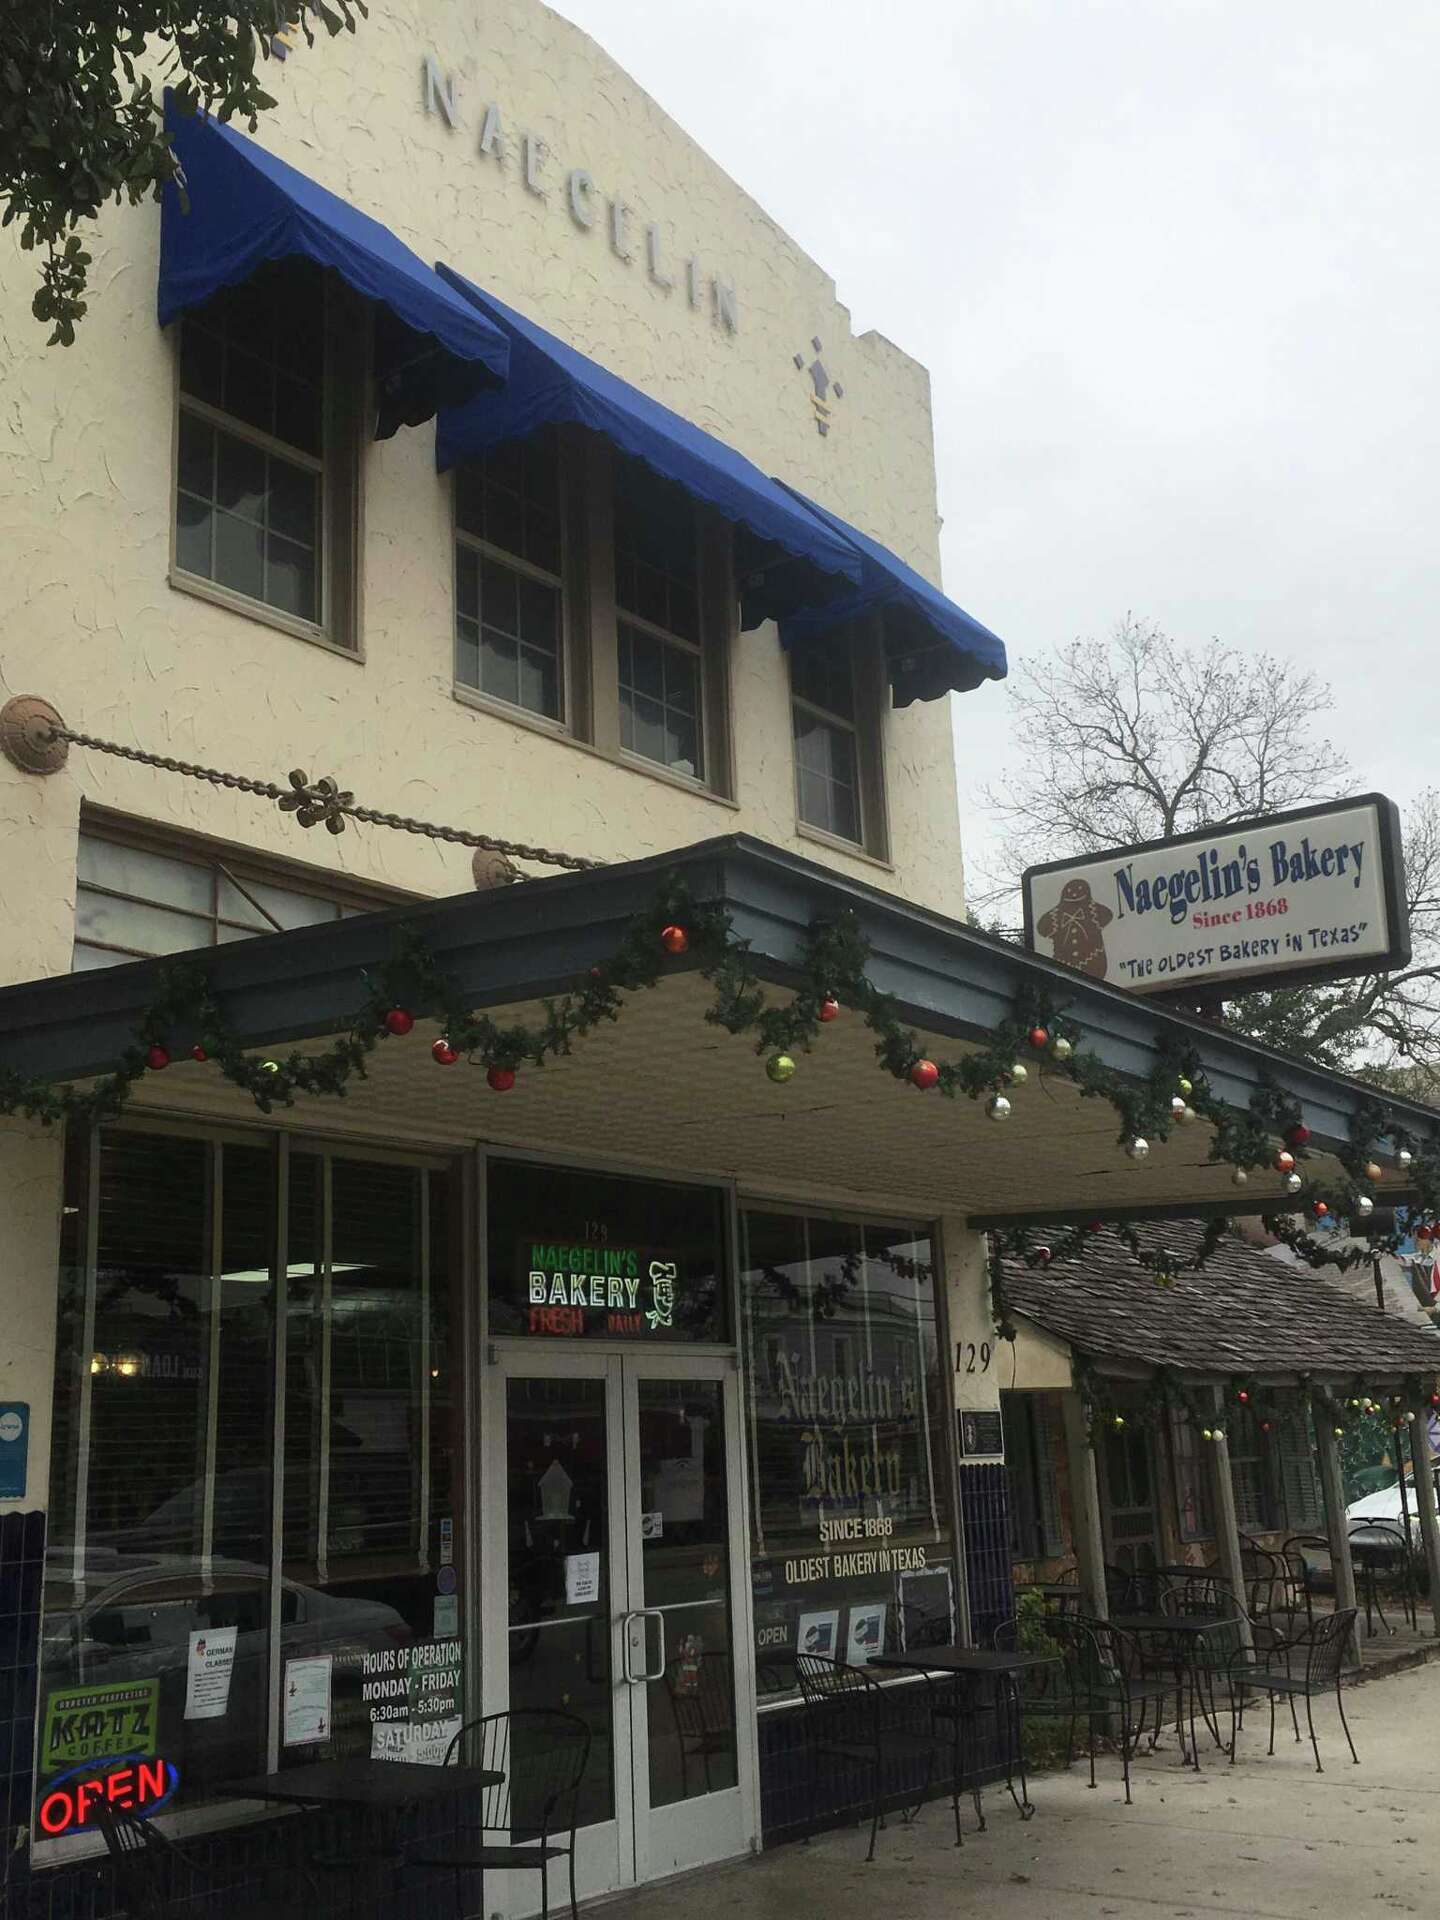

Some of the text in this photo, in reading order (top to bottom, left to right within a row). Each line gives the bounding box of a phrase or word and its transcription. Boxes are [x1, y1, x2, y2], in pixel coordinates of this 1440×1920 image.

[1114, 837, 1364, 925] Naegelin's Bakery
[1192, 898, 1288, 929] Since 1868
[531, 1245, 639, 1275] NAEGELIN'S
[529, 1271, 640, 1309] BAKERY
[529, 1307, 584, 1334] FRESH
[955, 1341, 991, 1373] 129
[819, 1516, 893, 1542] SINCE 1868
[785, 1556, 830, 1584] OLDEST
[833, 1551, 878, 1578] BAKERY
[879, 1551, 891, 1573] IN
[892, 1547, 926, 1572] TEXAS
[757, 1625, 788, 1646] OPEN
[206, 1646, 233, 1657] GERMAN
[363, 1641, 462, 1675] HOURS OF OPERATION
[362, 1676, 413, 1701] MONDAY
[422, 1669, 461, 1692] FRIDAY
[370, 1704, 409, 1722] 6:30am
[418, 1697, 455, 1714] 5:30pm
[50, 1702, 150, 1752] KATZ
[376, 1719, 448, 1749] SATURDAY
[40, 1759, 164, 1833] OPEN
